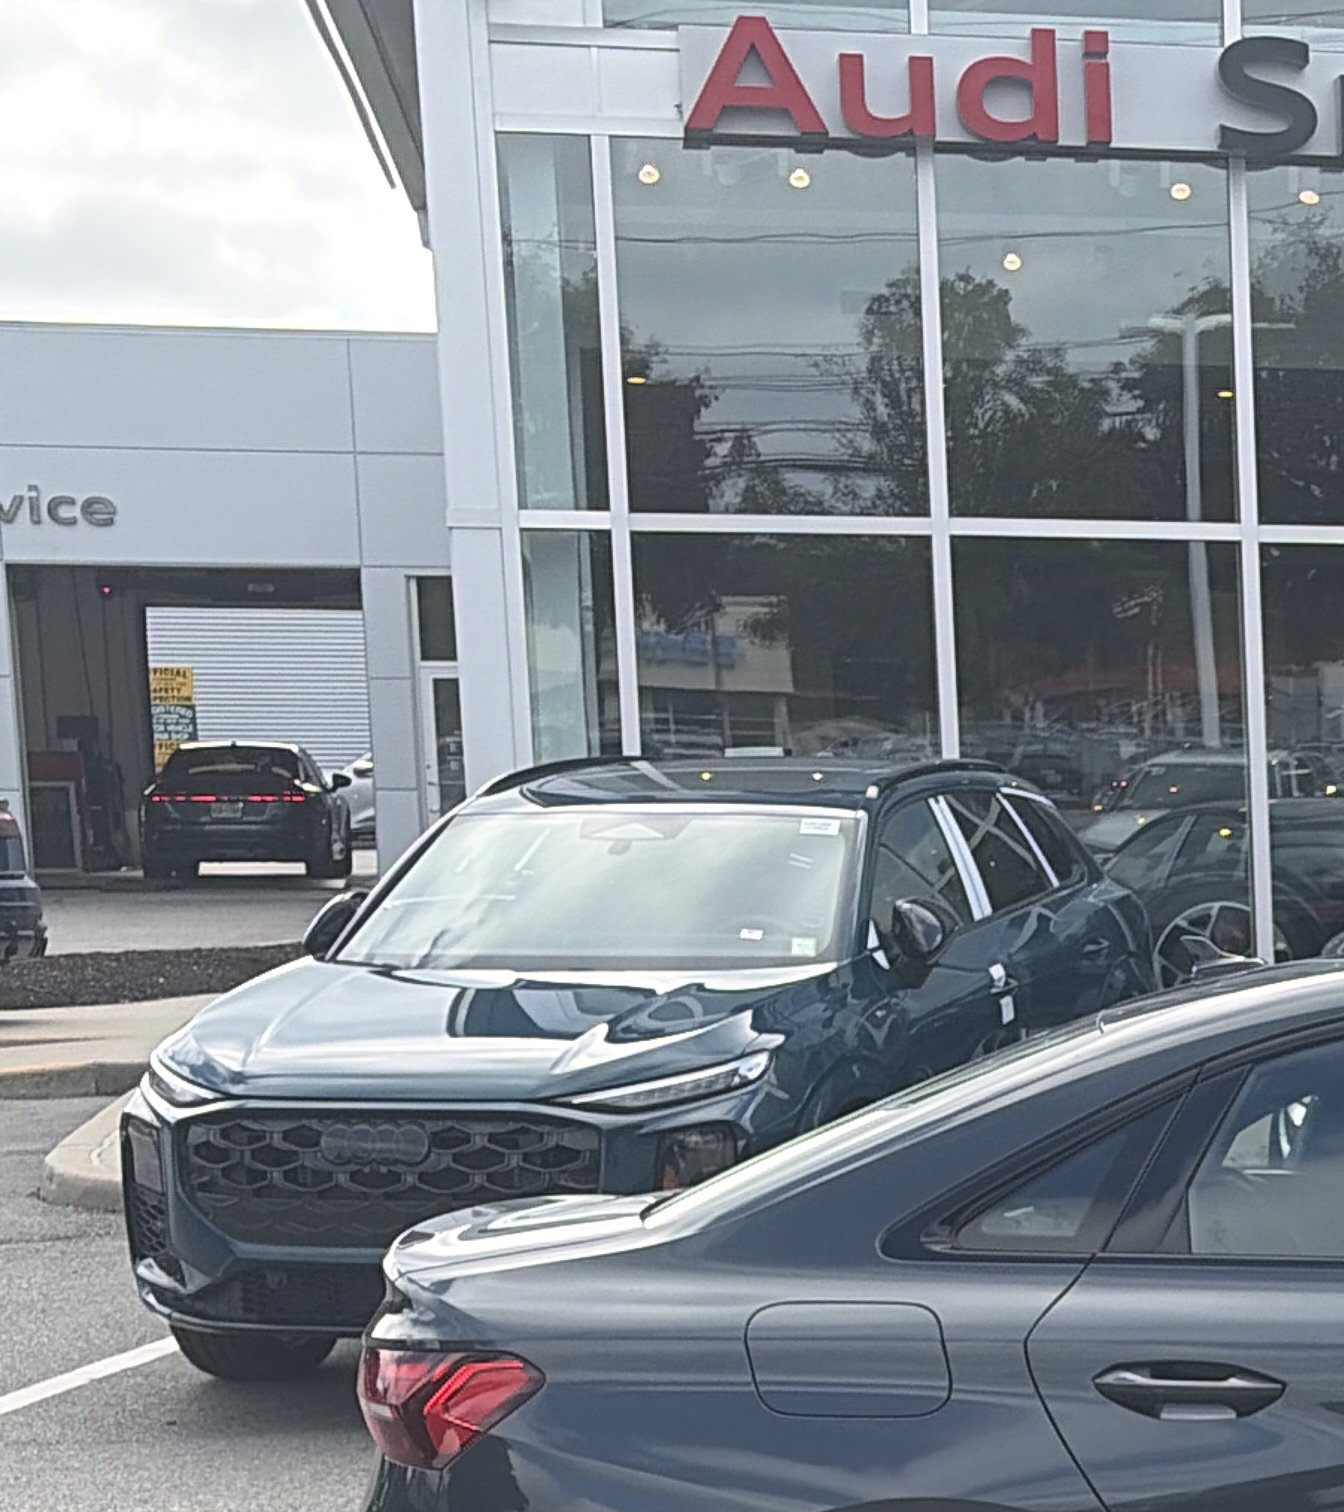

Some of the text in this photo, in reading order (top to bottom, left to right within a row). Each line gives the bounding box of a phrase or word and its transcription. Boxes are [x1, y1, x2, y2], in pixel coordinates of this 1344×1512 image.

[684, 15, 1113, 146] Audi
[0, 484, 117, 527] vice
[152, 667, 188, 679] FICIAL
[152, 695, 192, 703] PECTION
